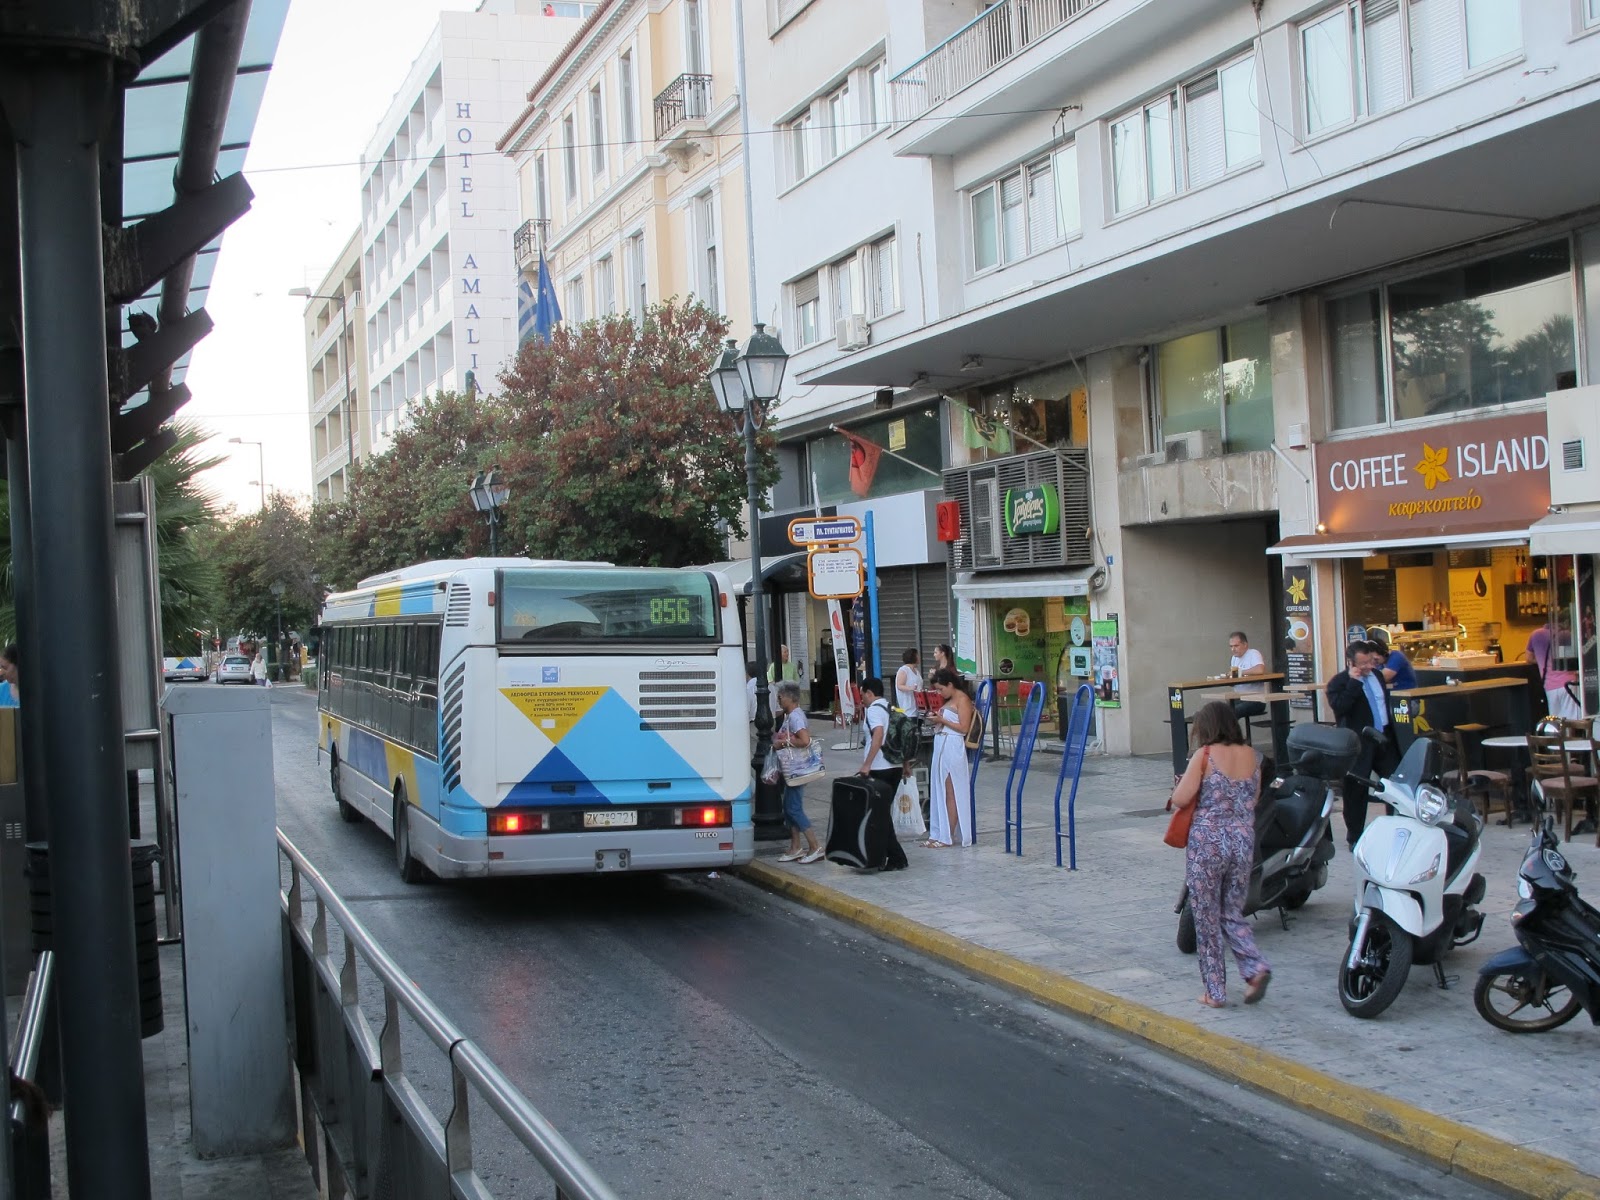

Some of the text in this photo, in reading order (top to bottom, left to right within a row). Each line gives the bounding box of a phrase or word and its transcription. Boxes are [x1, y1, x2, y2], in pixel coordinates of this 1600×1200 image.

[456, 102, 474, 218] HOTEL
[1329, 435, 1549, 492] COFFEE ISLAND
[1388, 488, 1482, 520] καφεκοπτείο
[650, 598, 690, 624] 856
[695, 831, 718, 839] IVECO
